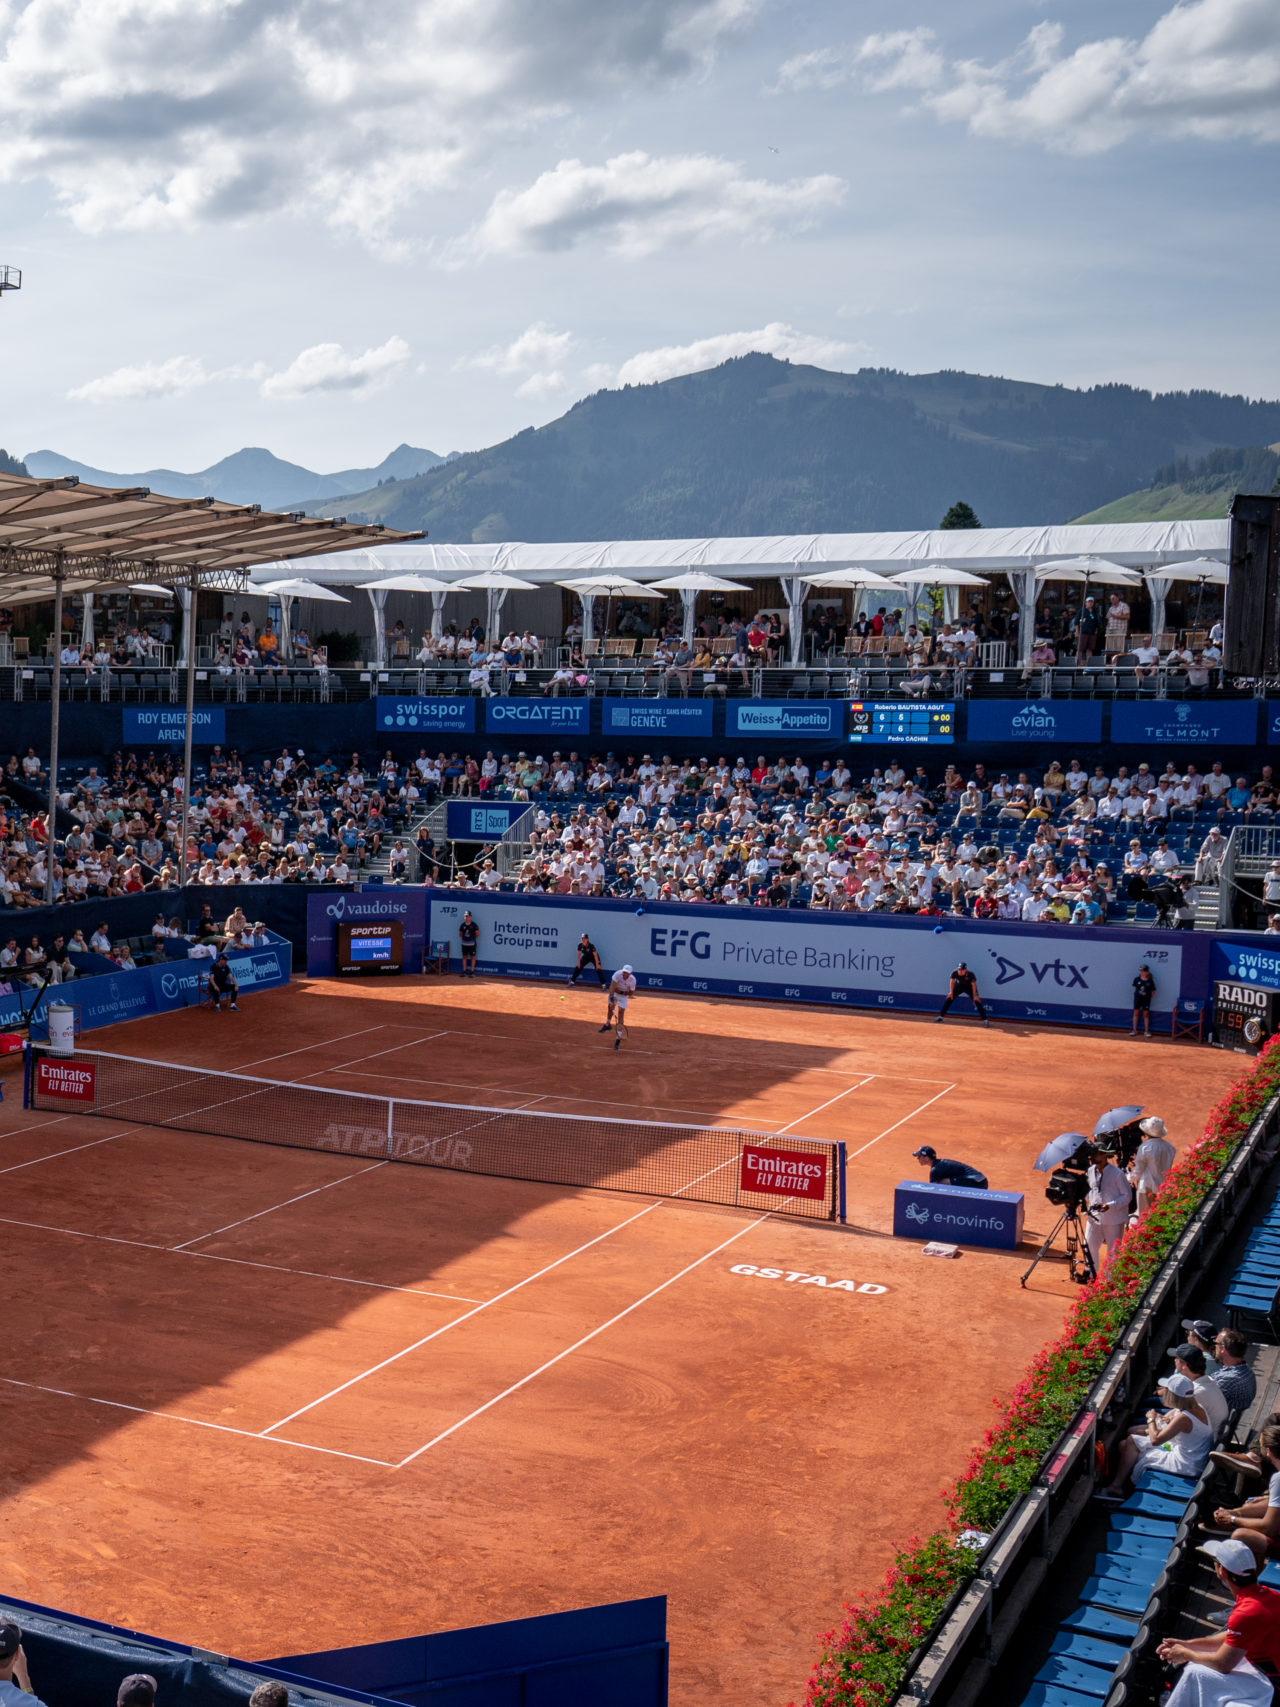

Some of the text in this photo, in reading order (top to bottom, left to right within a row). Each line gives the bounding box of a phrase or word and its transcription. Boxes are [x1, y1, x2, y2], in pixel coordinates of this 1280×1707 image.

[396, 702, 466, 719] swisspor
[940, 713, 951, 723] 00
[138, 713, 158, 725] ROY
[444, 721, 466, 730] energy
[1012, 713, 1056, 727] evian
[158, 728, 186, 741] AREN
[879, 724, 885, 733] 7
[939, 725, 950, 734] 00
[1012, 728, 1055, 739] Live young
[1145, 727, 1220, 738] TELMONT
[474, 810, 483, 830] RTS
[488, 814, 507, 829] Sport
[347, 900, 408, 915] vaudoise
[494, 921, 558, 937] Interiman
[493, 934, 533, 950] Group
[650, 927, 895, 979] EFG Private Banking
[1030, 958, 1089, 989] vtx
[648, 977, 663, 987] EFG
[693, 981, 708, 990] EFG
[738, 985, 753, 994] EFG
[785, 988, 800, 997] EFG
[831, 991, 847, 1001] EFG
[878, 995, 894, 1004] EFG
[1218, 984, 1267, 1008] RADO
[1218, 1001, 1266, 1017] SWITZERLAND
[41, 1064, 92, 1083] Emirates
[48, 1079, 84, 1094] FLY BETTER
[316, 1123, 473, 1167] ATP TOUR
[746, 1153, 822, 1178] Emirates
[756, 1172, 810, 1191] FLY BETTER
[933, 1212, 1004, 1231] e-novinfo
[729, 1264, 890, 1295] GSTAAD
